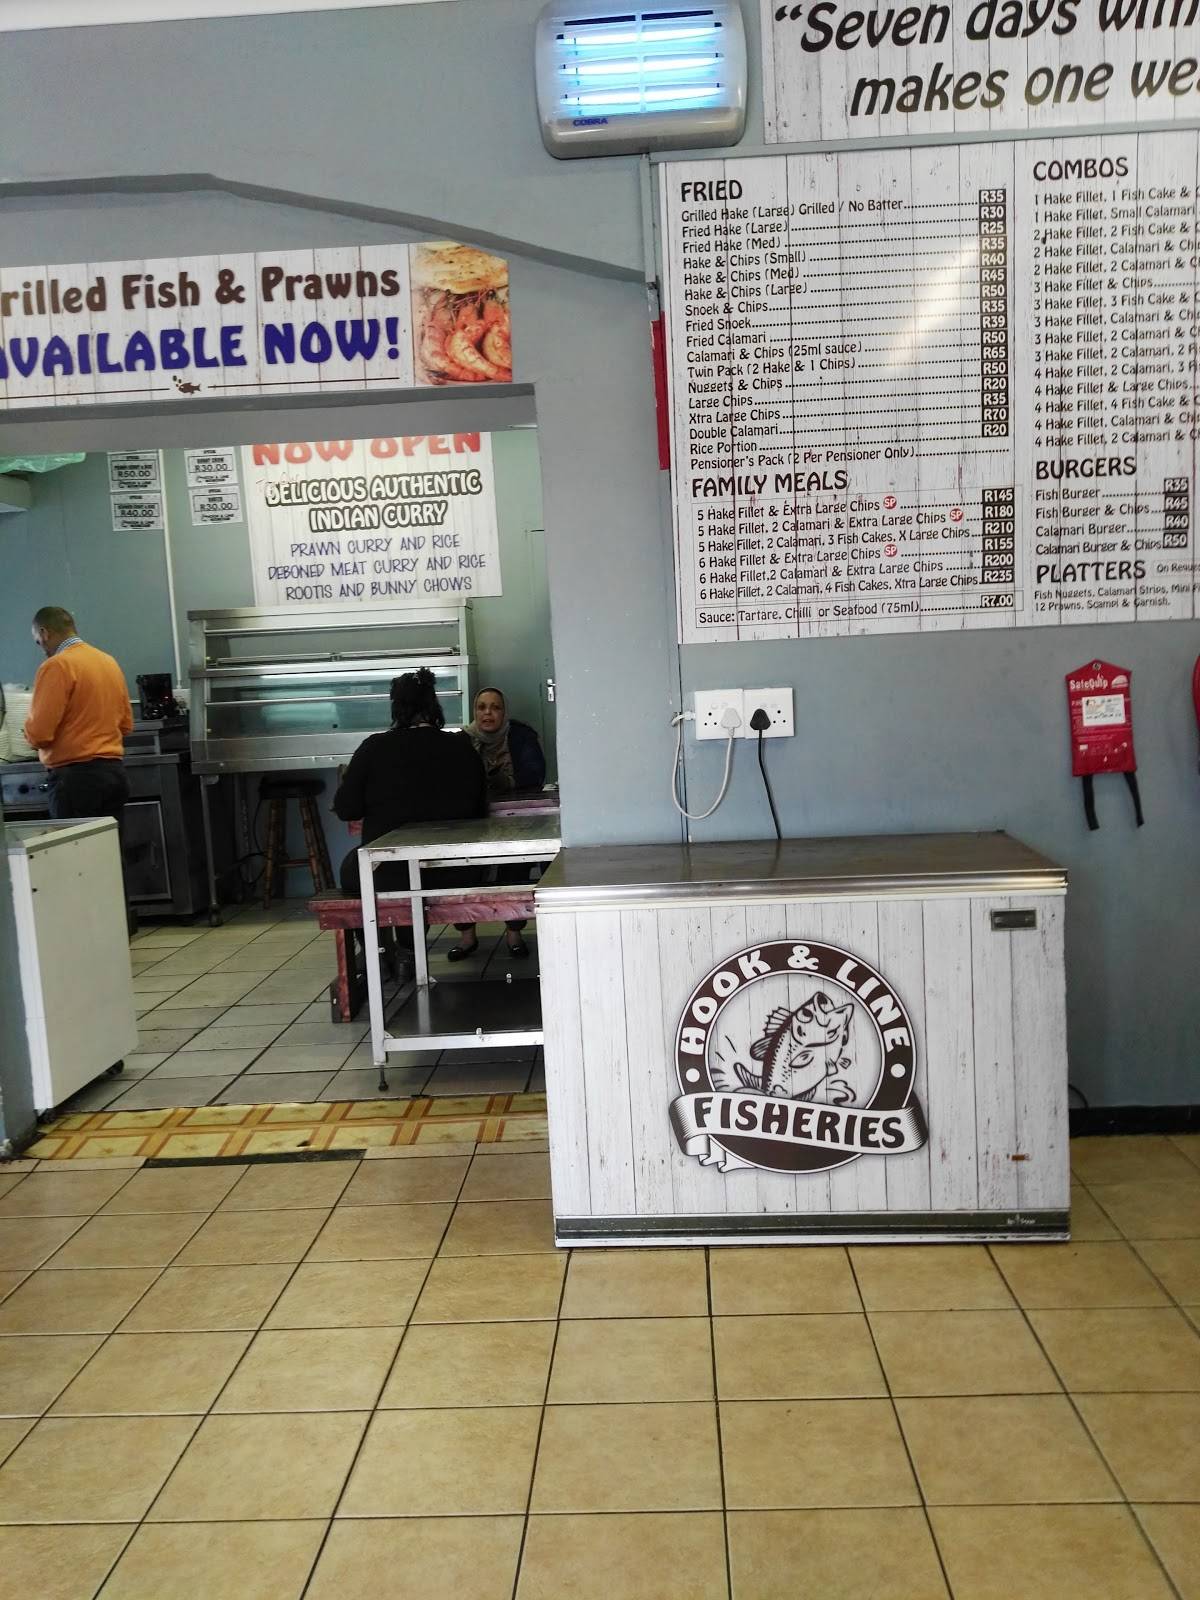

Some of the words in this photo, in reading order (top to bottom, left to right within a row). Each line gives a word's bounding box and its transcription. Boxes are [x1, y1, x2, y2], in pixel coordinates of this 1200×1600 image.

[965, 0, 1081, 41] days
[850, 62, 1010, 116] makes
[1024, 62, 1114, 106] one
[1131, 57, 1200, 98] we
[1033, 157, 1129, 181] COMBOS
[681, 180, 743, 202] FRIED
[681, 209, 717, 222] Grilled
[721, 208, 749, 220] Hake
[753, 204, 795, 218] (Large)
[799, 202, 835, 215] Grilled
[848, 201, 864, 212] No
[981, 190, 1004, 203] R35
[682, 226, 711, 238] Fried
[714, 224, 742, 236] Hake
[745, 220, 788, 234] (Large)
[981, 206, 1004, 218] R30
[683, 257, 711, 269] Hake
[715, 256, 727, 267] &
[730, 254, 760, 268] Chips
[764, 251, 806, 264] (Small)
[981, 237, 1005, 250] R35
[122, 271, 200, 310] Fish
[215, 268, 245, 304] &
[262, 266, 399, 302] Prawns
[1034, 281, 1041, 293] 3
[1044, 280, 1072, 292] Hake
[1076, 279, 1104, 291] Fillet
[1107, 278, 1118, 289] &
[1122, 276, 1153, 289] Chips
[685, 303, 719, 316] Snoek
[723, 302, 734, 314] &
[737, 301, 768, 314] Chips
[982, 285, 1005, 297] R50
[686, 319, 713, 332] Fried
[717, 317, 751, 330] Snoek
[982, 301, 1005, 313] R35
[686, 335, 714, 347] Fried
[718, 332, 766, 345] Calamari
[982, 316, 1006, 329] R39
[265, 317, 399, 365] NOW!
[687, 349, 735, 363] Calamari
[739, 348, 750, 360] &
[754, 347, 784, 359] Chips
[788, 343, 821, 357] (25ml
[825, 341, 862, 355] sauce)
[982, 332, 1006, 344] R50
[688, 381, 734, 394] Nuggets
[738, 379, 749, 391] &
[752, 378, 783, 391] Chips
[983, 362, 1006, 374] R50
[1034, 385, 1042, 397] 4
[1045, 384, 1073, 396] Hake
[1077, 382, 1104, 394] Fillet
[1108, 381, 1118, 393] &
[1123, 380, 1154, 392] Large
[1157, 378, 1188, 391] Chips
[688, 413, 712, 425] Xtra
[716, 411, 747, 423] Large
[750, 409, 781, 421] Chips
[983, 394, 1006, 406] R35
[689, 427, 727, 440] Double
[730, 423, 778, 438] Calamari
[983, 408, 1007, 421] R70
[253, 440, 353, 466] NOW
[370, 432, 480, 459] OPEN
[758, 453, 784, 466] Pack
[787, 452, 800, 465] (2
[803, 451, 823, 464] Per
[826, 449, 881, 463] Pensioner
[884, 446, 915, 458] Only)
[1036, 456, 1137, 480] BURGERS
[265, 476, 368, 507] DELICIOUS
[369, 469, 483, 499] AUTHENTIC
[692, 474, 768, 498] FAMILY
[775, 470, 848, 493] MEALS
[1035, 489, 1058, 501] Fish
[1062, 488, 1101, 500] Burger
[309, 505, 380, 533] INDIAN
[383, 500, 448, 527] CURRY
[697, 510, 704, 521] 5
[707, 508, 735, 520] Hake
[738, 506, 765, 519] Fillet
[768, 505, 780, 517] &
[783, 504, 812, 516] Extra
[816, 501, 847, 514] Large
[849, 499, 880, 512] Chips
[984, 489, 1013, 502] R145
[1035, 507, 1058, 519] Fish
[1062, 506, 1100, 518] Burger
[1104, 505, 1116, 516] &
[1119, 503, 1150, 515] Chips
[1166, 497, 1188, 510] R45
[1035, 525, 1084, 537] Calamari
[1088, 523, 1126, 535] Burger
[1166, 515, 1188, 528] R40
[291, 541, 341, 557] PRAWN
[348, 538, 393, 554] CURRY
[400, 535, 426, 550] AND
[432, 534, 461, 548] RICE
[698, 557, 706, 569] 6
[709, 556, 736, 568] Hake
[739, 554, 766, 567] Fillet
[769, 553, 781, 565] &
[784, 552, 813, 564] Extra
[817, 550, 848, 562] Large
[851, 548, 881, 560] Chips
[985, 537, 1013, 550] R155
[1035, 543, 1080, 555] Calamari
[1083, 541, 1118, 553] Burger
[1121, 540, 1131, 551] &
[1134, 539, 1161, 550] Chips
[1164, 534, 1187, 547] R50
[268, 564, 325, 580] DEBONED
[331, 561, 367, 577] MEAT
[374, 558, 419, 574] CURRY
[426, 556, 452, 571] AND
[458, 554, 486, 568] RICE
[1036, 560, 1146, 584] PLATTERS
[286, 586, 333, 601] ROOTIS
[339, 582, 365, 598] AND
[371, 580, 417, 596] BUNNY
[424, 577, 473, 592] CHOWS
[699, 612, 735, 624] Sauce:
[785, 606, 811, 619] Chilli
[818, 607, 830, 618] or
[833, 604, 878, 617] Seafood
[881, 601, 919, 614] (75ml)
[982, 595, 1013, 608] R7.00
[681, 950, 772, 1055] HOOK
[787, 945, 819, 971] &
[836, 959, 911, 1053] LINE
[694, 1096, 905, 1150] FISHERIES
